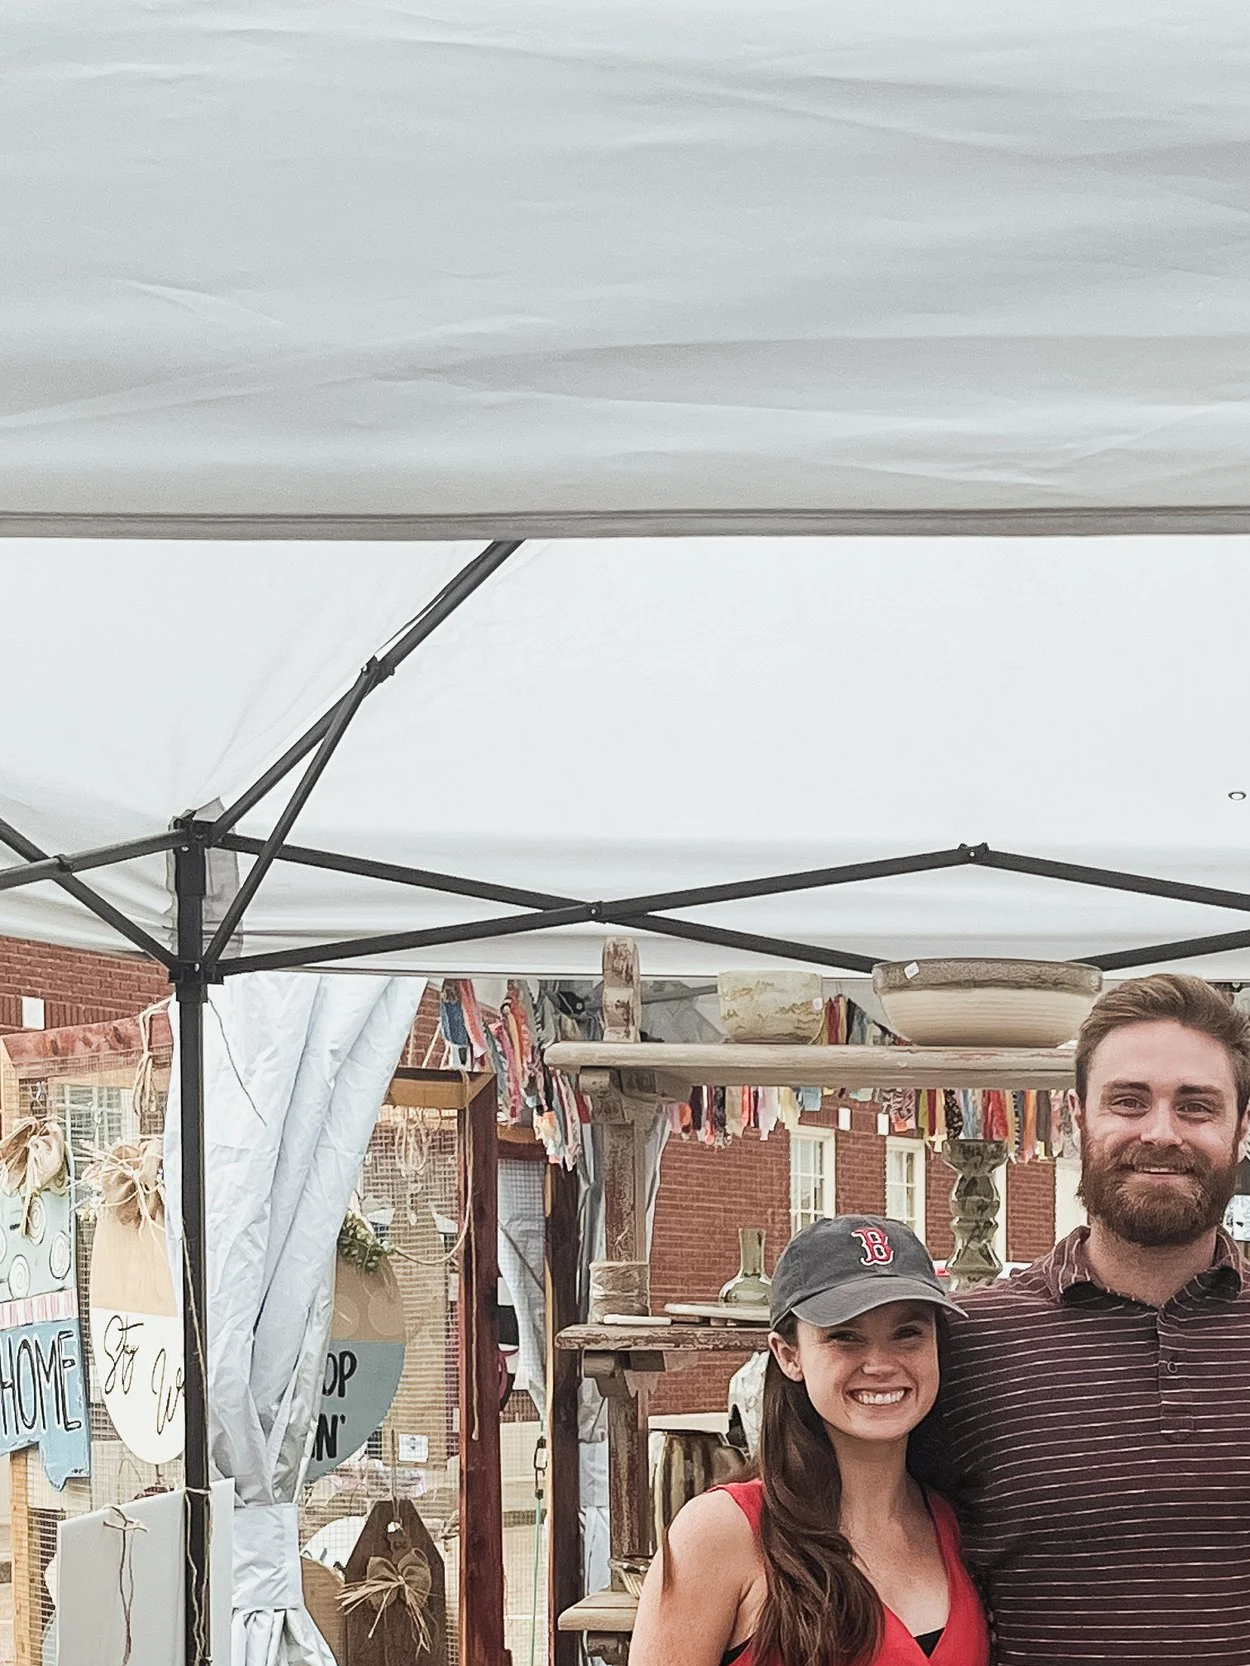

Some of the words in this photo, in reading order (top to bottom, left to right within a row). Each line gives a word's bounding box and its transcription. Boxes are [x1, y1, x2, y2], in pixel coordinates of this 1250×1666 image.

[850, 1226, 895, 1267] B
[0, 1330, 82, 1436] HOME
[322, 1350, 358, 1398] OP
[311, 1412, 346, 1461] N'
